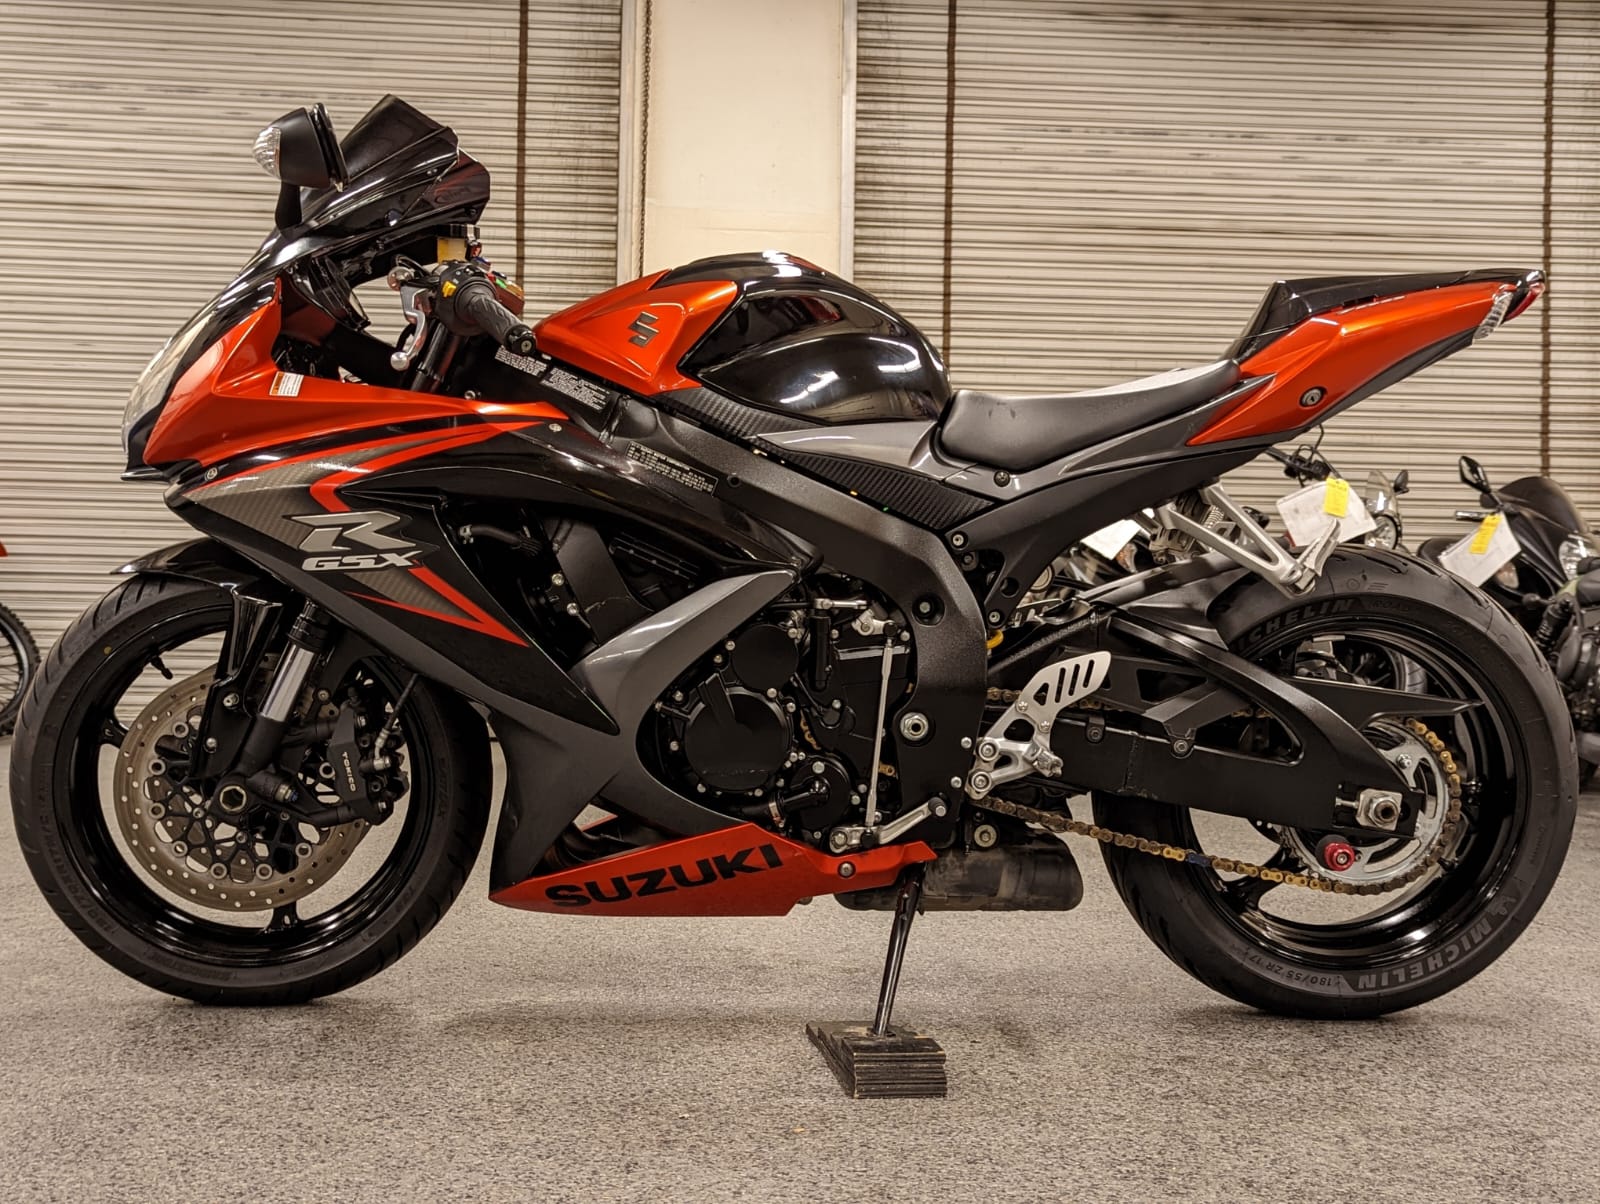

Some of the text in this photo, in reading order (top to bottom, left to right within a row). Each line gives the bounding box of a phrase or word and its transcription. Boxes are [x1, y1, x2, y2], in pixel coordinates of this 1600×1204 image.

[291, 510, 417, 552] R
[301, 550, 424, 571] GSX
[1231, 597, 1354, 652] ICHELIN
[341, 751, 357, 792] TOKICO
[545, 843, 784, 907] SUZUKI
[1249, 954, 1332, 986] 180/55 ZR 17
[1358, 918, 1492, 989] MICHELIN
